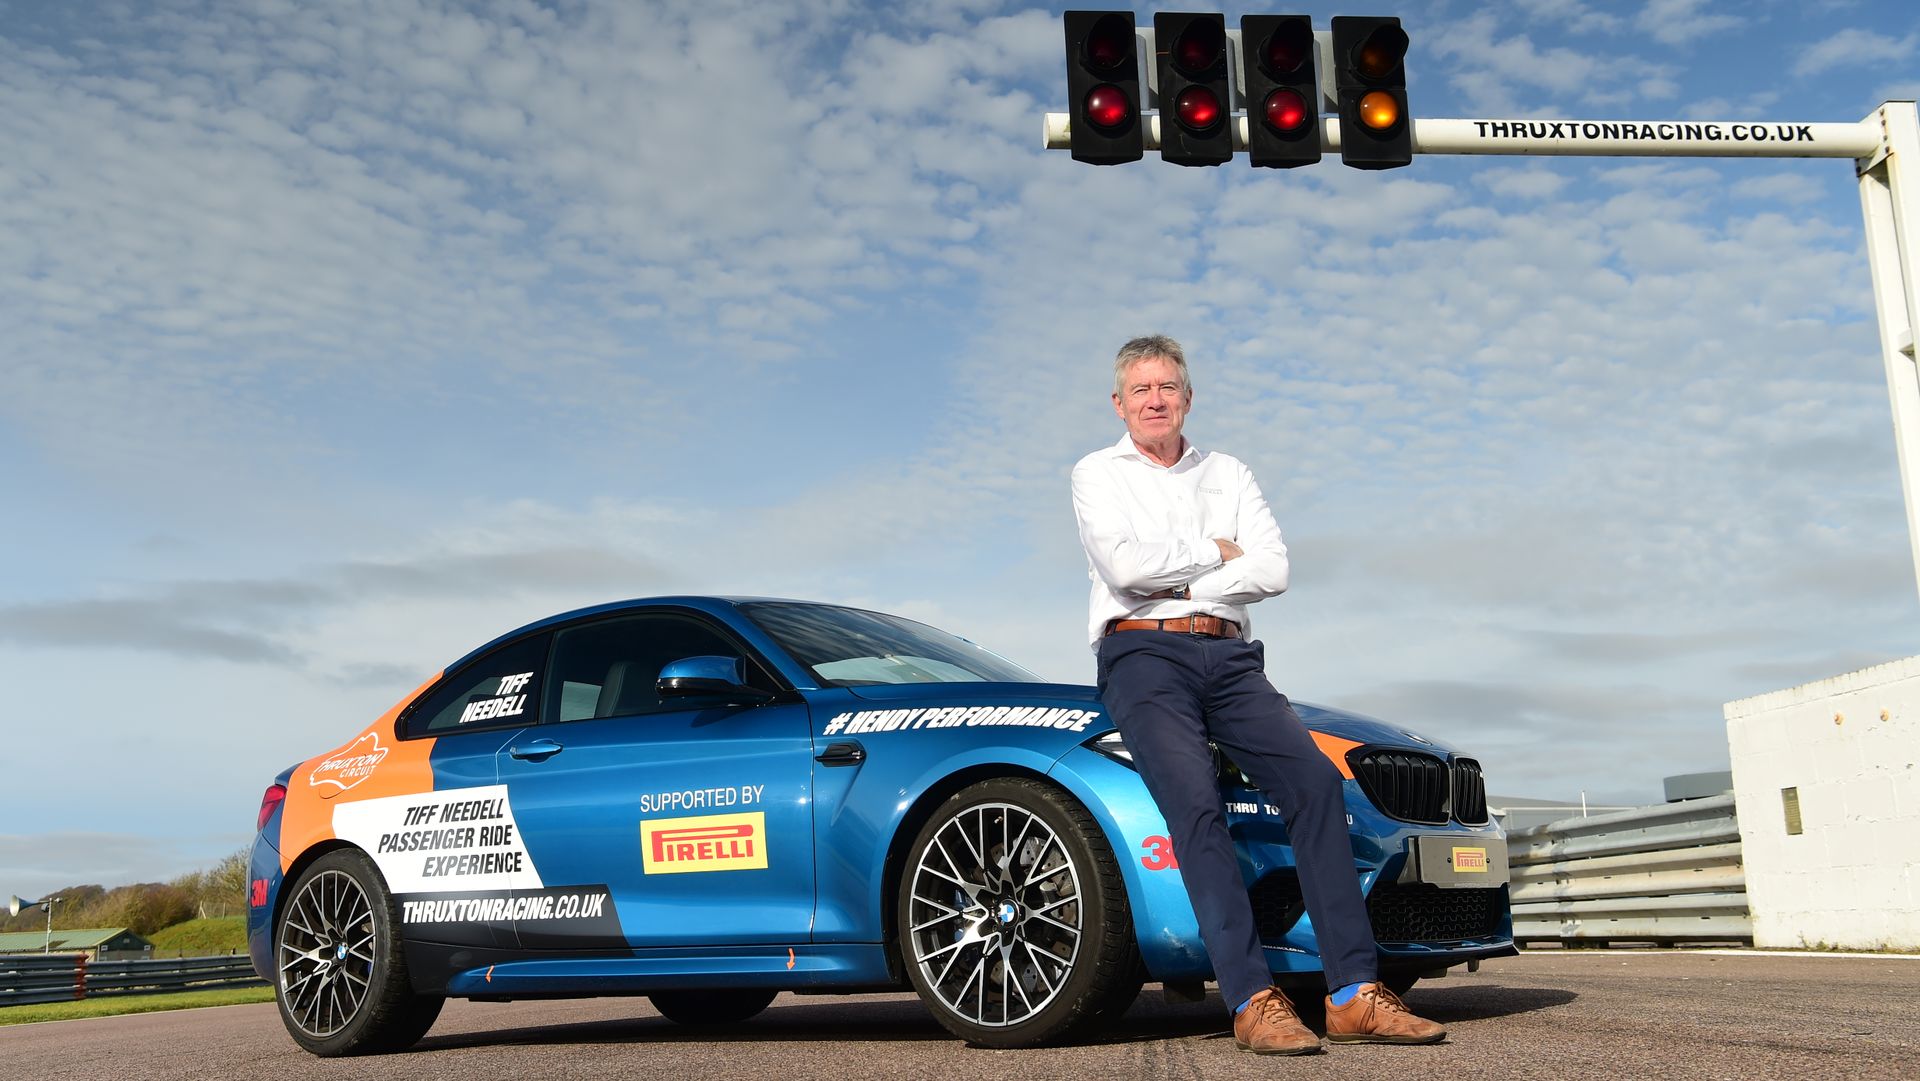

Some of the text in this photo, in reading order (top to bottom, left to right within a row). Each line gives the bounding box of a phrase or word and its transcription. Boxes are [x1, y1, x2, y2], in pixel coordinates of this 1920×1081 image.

[1473, 121, 1815, 141] THRUXTONRACING.CO.UK
[496, 671, 534, 696] TIFF
[459, 693, 528, 724] NEEDELL
[318, 753, 383, 773] THRUXTON
[339, 765, 377, 778] CIRCUIT
[640, 784, 765, 813] SUPPORTED BY
[1225, 802, 1258, 814] THRU
[403, 798, 504, 827] TIFF NEEDELL
[377, 824, 513, 854] PASSENGER RIDE
[651, 823, 754, 863] PIRELLI
[422, 851, 522, 878] EXPERIENCE
[1456, 851, 1484, 867] PIRELLI
[251, 879, 269, 907] 3M
[402, 893, 607, 924] THRUXTONRACING.CO.UK
